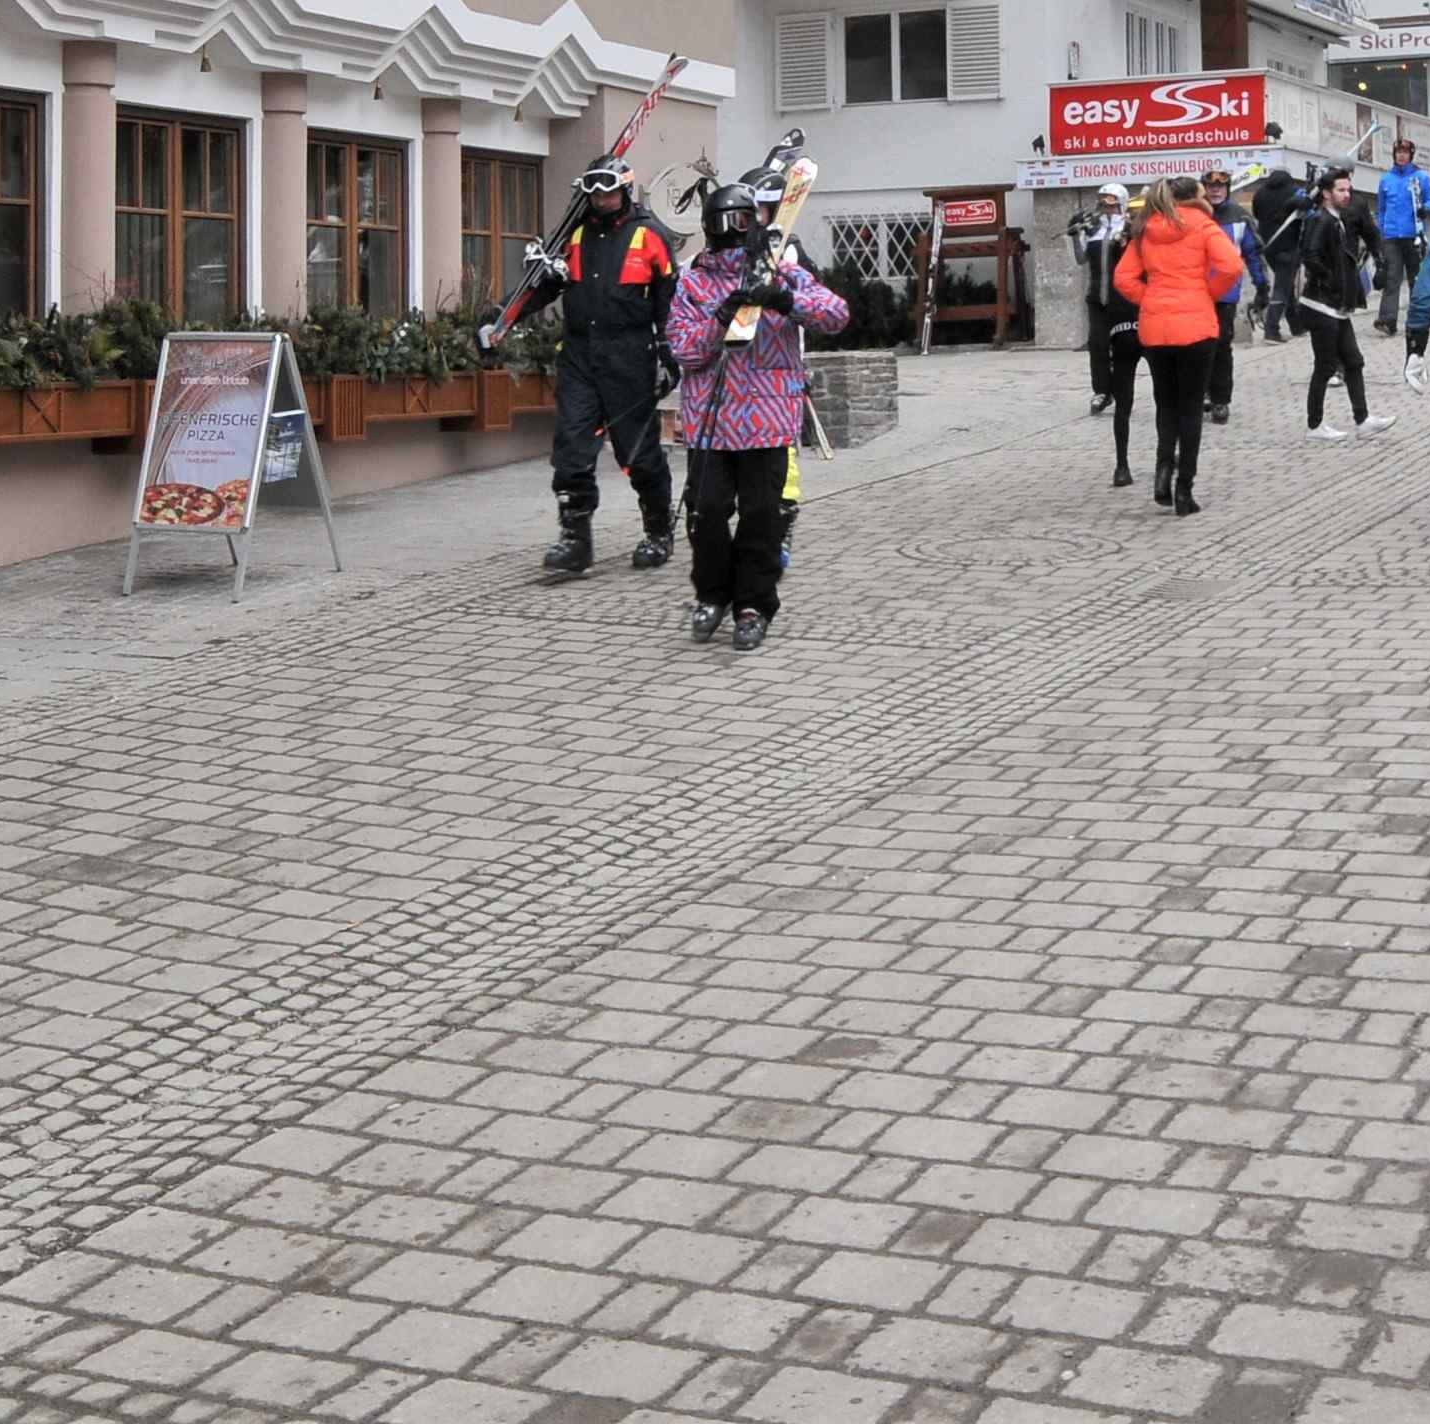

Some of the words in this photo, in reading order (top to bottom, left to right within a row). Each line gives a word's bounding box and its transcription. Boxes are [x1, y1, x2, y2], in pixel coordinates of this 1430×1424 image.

[1359, 33, 1393, 50] Ski
[1063, 98, 1141, 129] easy
[1144, 79, 1250, 128] Ski
[1064, 136, 1086, 150] ski
[1092, 137, 1101, 149] &
[1106, 127, 1251, 148] snowboardschule
[1073, 160, 1128, 178] EINGANG
[187, 429, 226, 442] PIZZA
